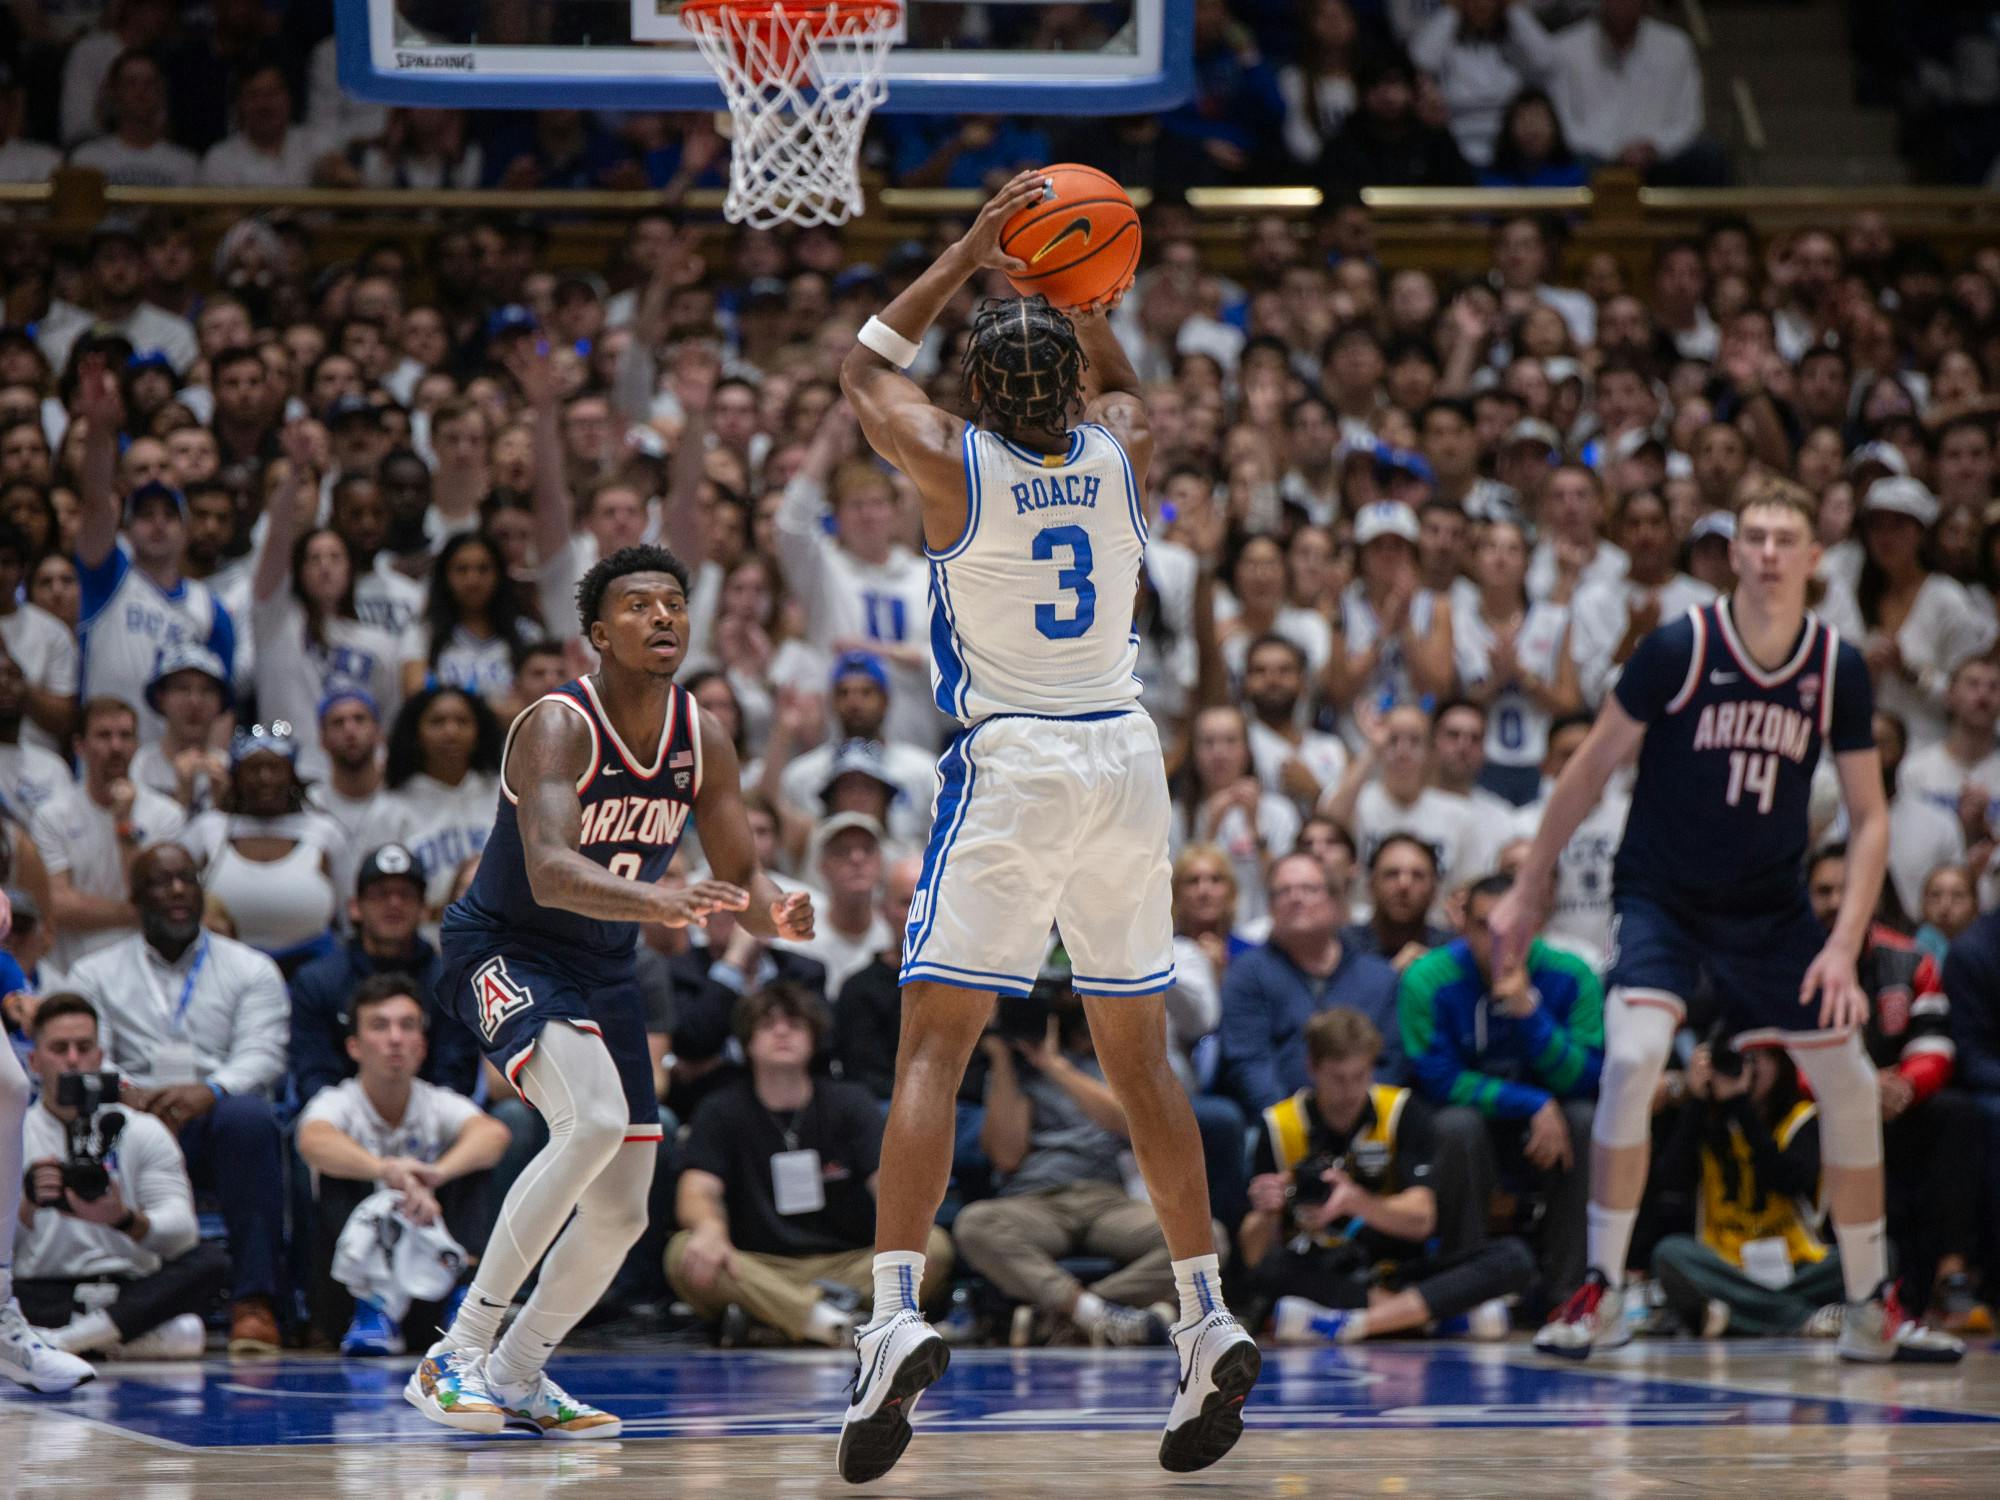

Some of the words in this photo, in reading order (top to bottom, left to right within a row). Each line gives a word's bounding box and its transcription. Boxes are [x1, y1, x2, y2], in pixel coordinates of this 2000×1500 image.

[396, 52, 475, 72] SPALDING
[1011, 475, 1101, 515] ROACH
[1032, 524, 1097, 640] 3
[1693, 700, 1813, 765] ARIZONA
[1726, 750, 1780, 815] 14
[580, 796, 690, 845] ARIZONA
[472, 956, 533, 1042] A
